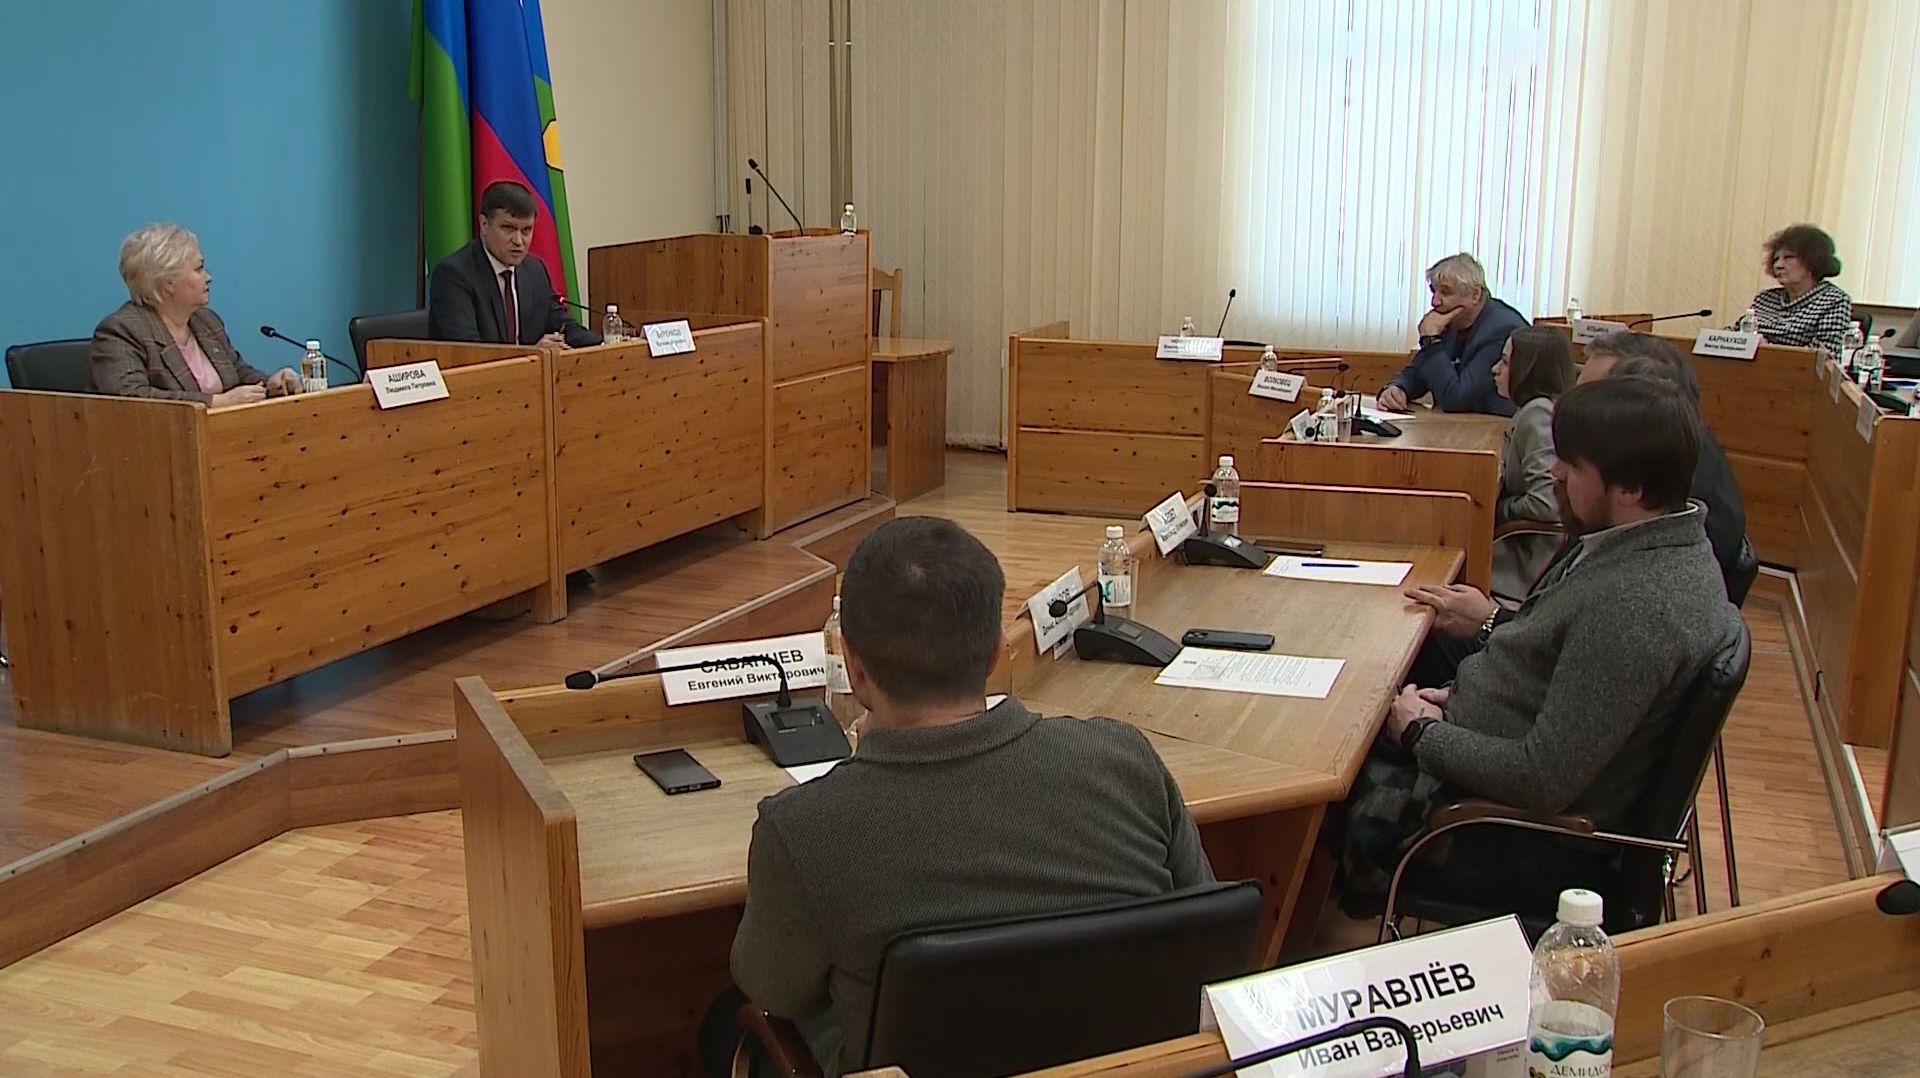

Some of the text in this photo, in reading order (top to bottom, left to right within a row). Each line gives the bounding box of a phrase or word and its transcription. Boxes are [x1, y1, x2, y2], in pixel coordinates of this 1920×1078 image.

[387, 369, 427, 383] АШИРОВА
[688, 675, 744, 691] Евгений
[1296, 962, 1476, 1031] МУРАВЛЁВ
[1297, 1040, 1361, 1070] Иван
[1550, 1064, 1609, 1077] ДЕМИДО
